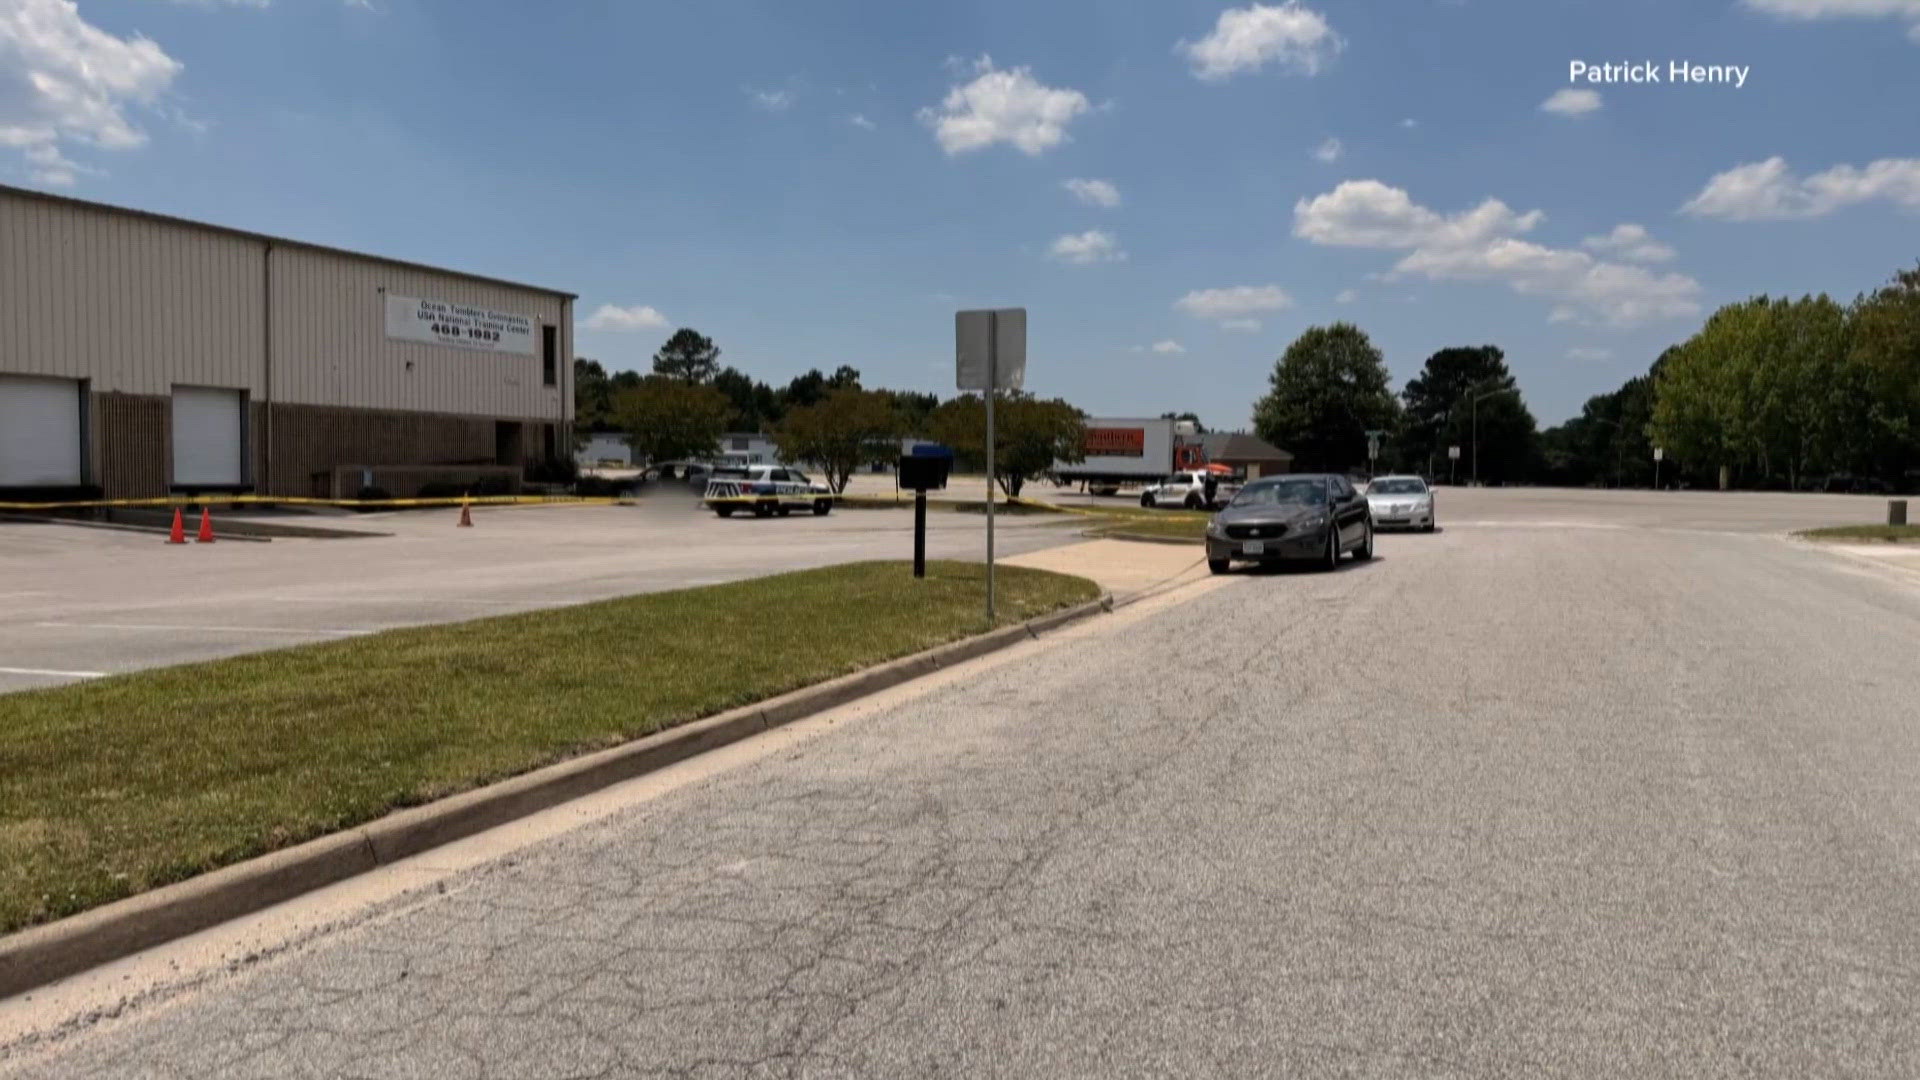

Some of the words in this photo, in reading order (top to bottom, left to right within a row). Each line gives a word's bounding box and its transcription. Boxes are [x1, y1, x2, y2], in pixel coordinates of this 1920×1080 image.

[421, 300, 446, 313] Ocean
[451, 305, 484, 319] Tumblers
[417, 310, 435, 321] USA
[438, 313, 471, 326] National
[474, 319, 504, 332] Training
[506, 325, 530, 336] Center
